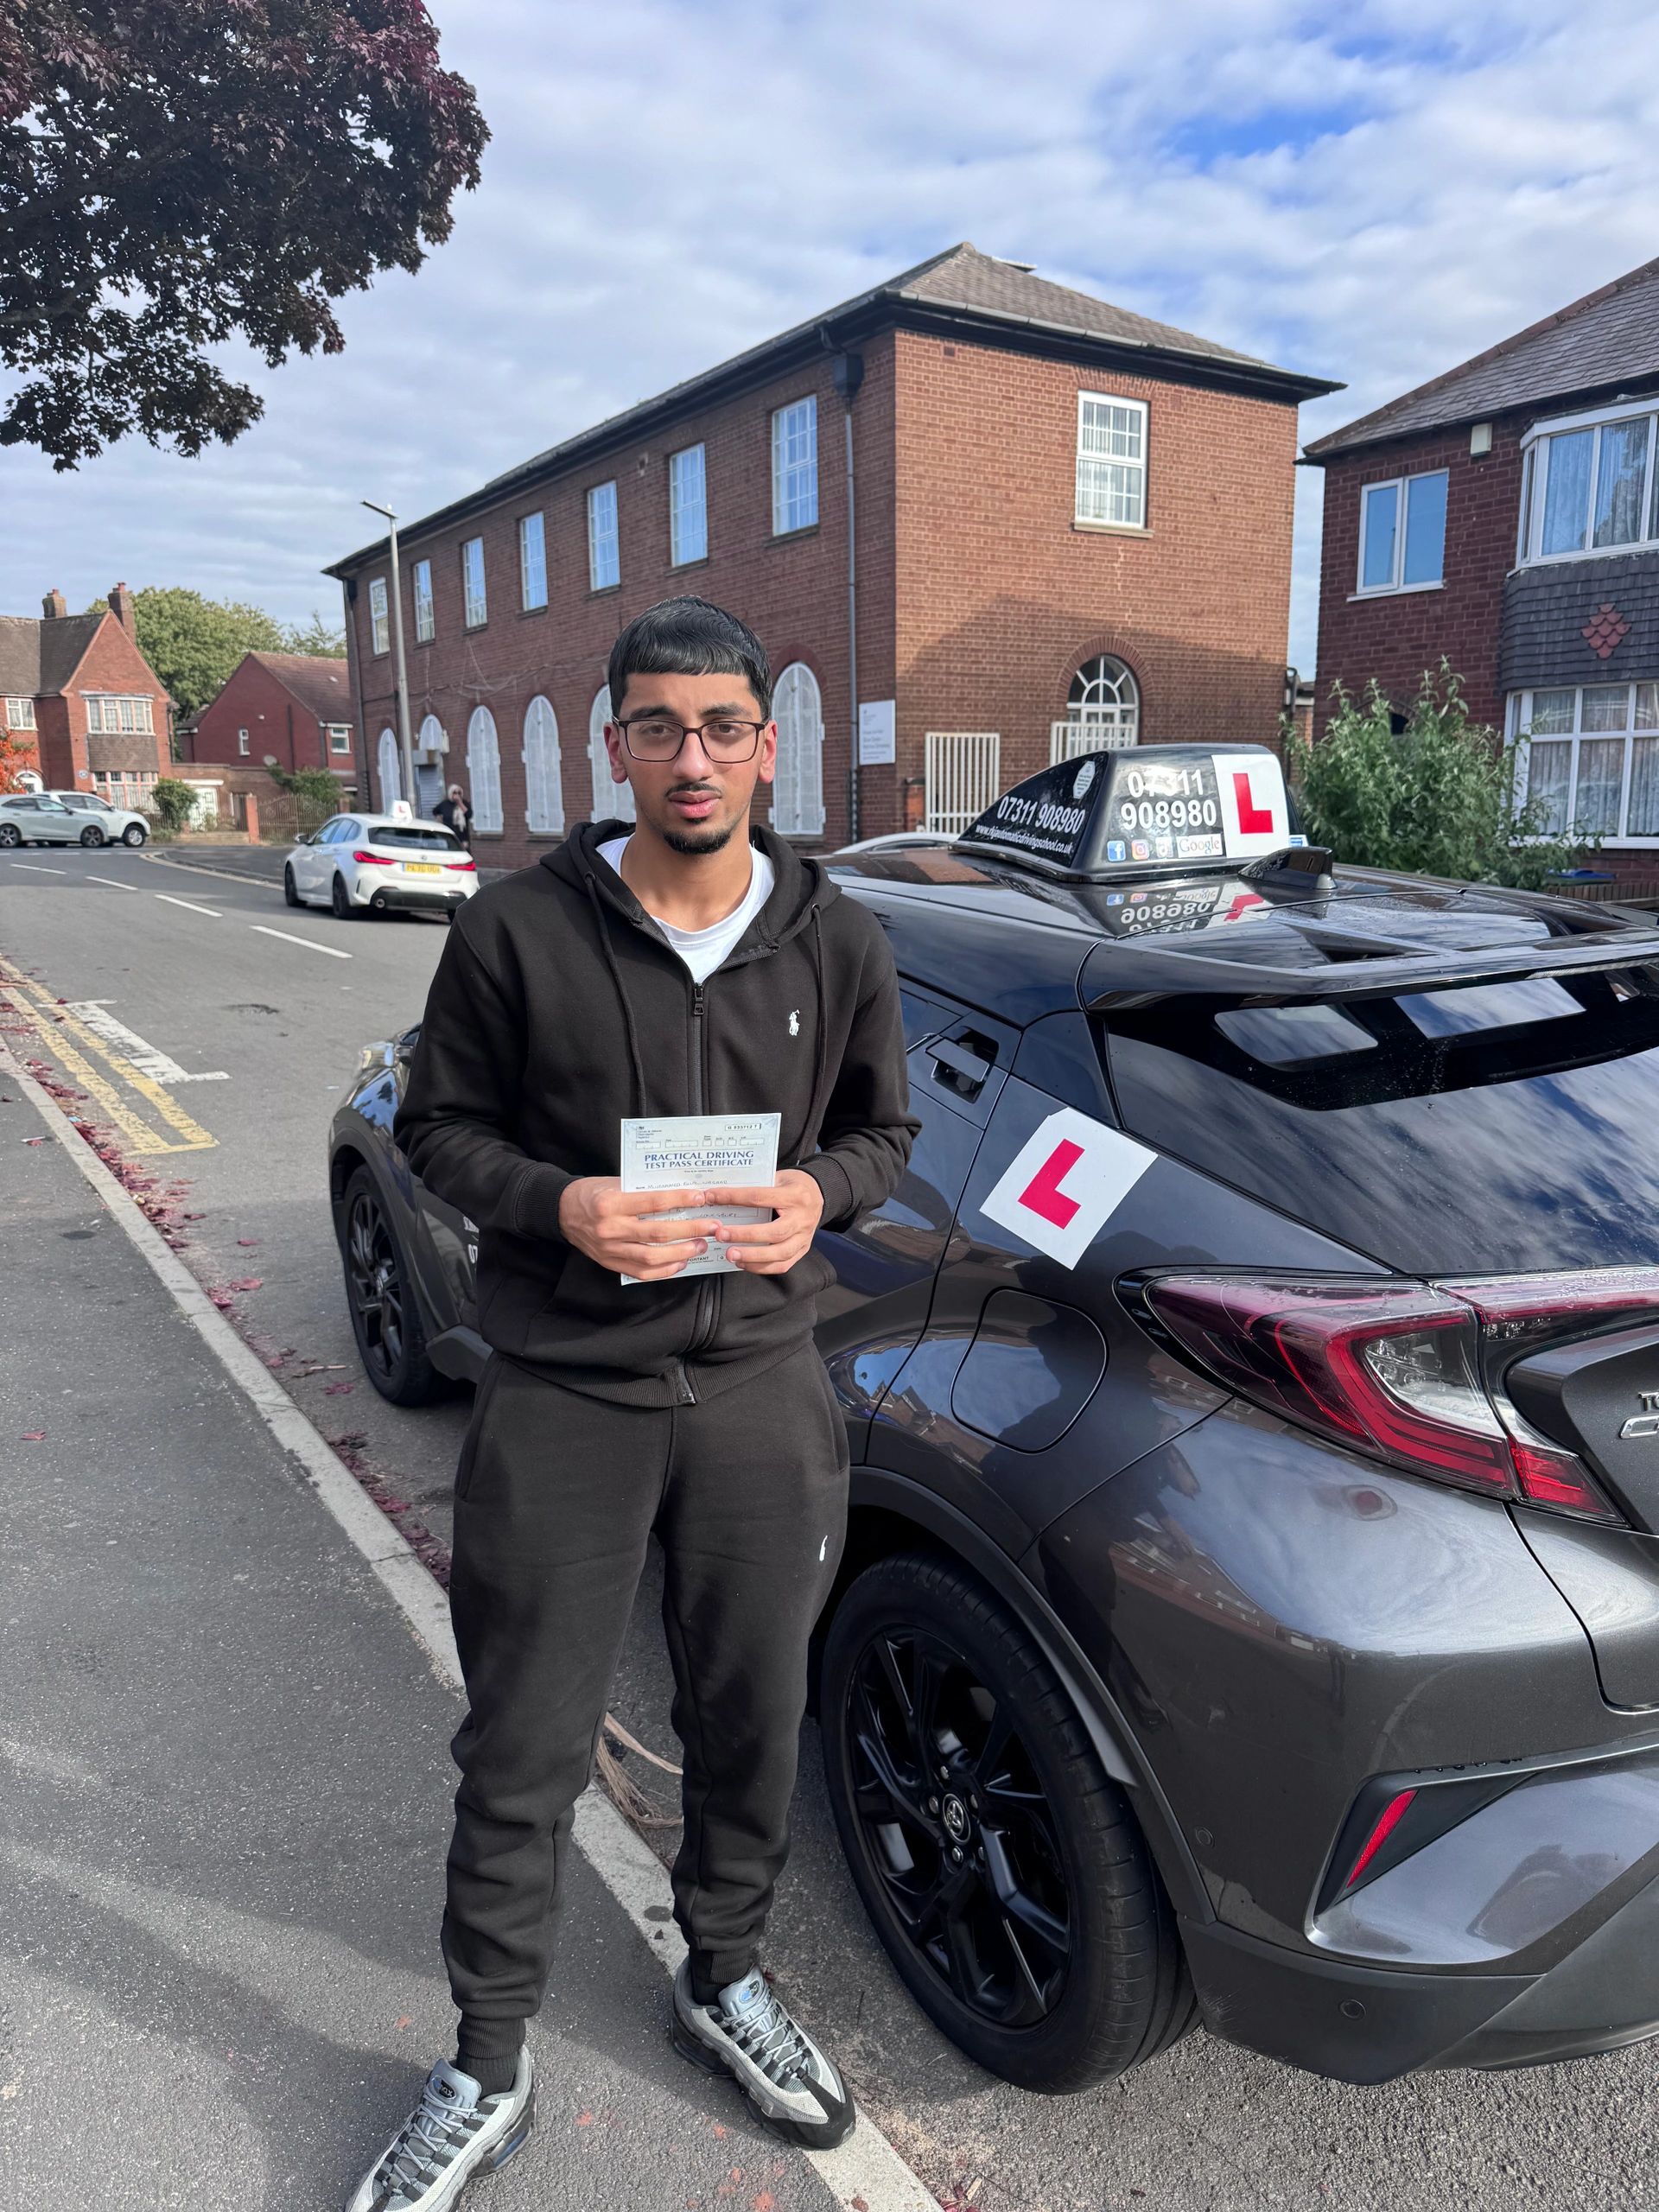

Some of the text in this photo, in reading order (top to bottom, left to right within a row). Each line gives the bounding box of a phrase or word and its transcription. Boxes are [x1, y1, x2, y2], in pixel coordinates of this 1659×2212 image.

[997, 796, 1086, 835] 07311 908980
[1121, 799, 1217, 830] 908980
[1233, 772, 1274, 834] L
[1179, 836, 1220, 855] Google
[645, 1150, 754, 1162] PRACTICAL DRIVING
[645, 1161, 666, 1170] TEST
[694, 1159, 753, 1167] CERTIFICATE
[1018, 1138, 1085, 1230] L
